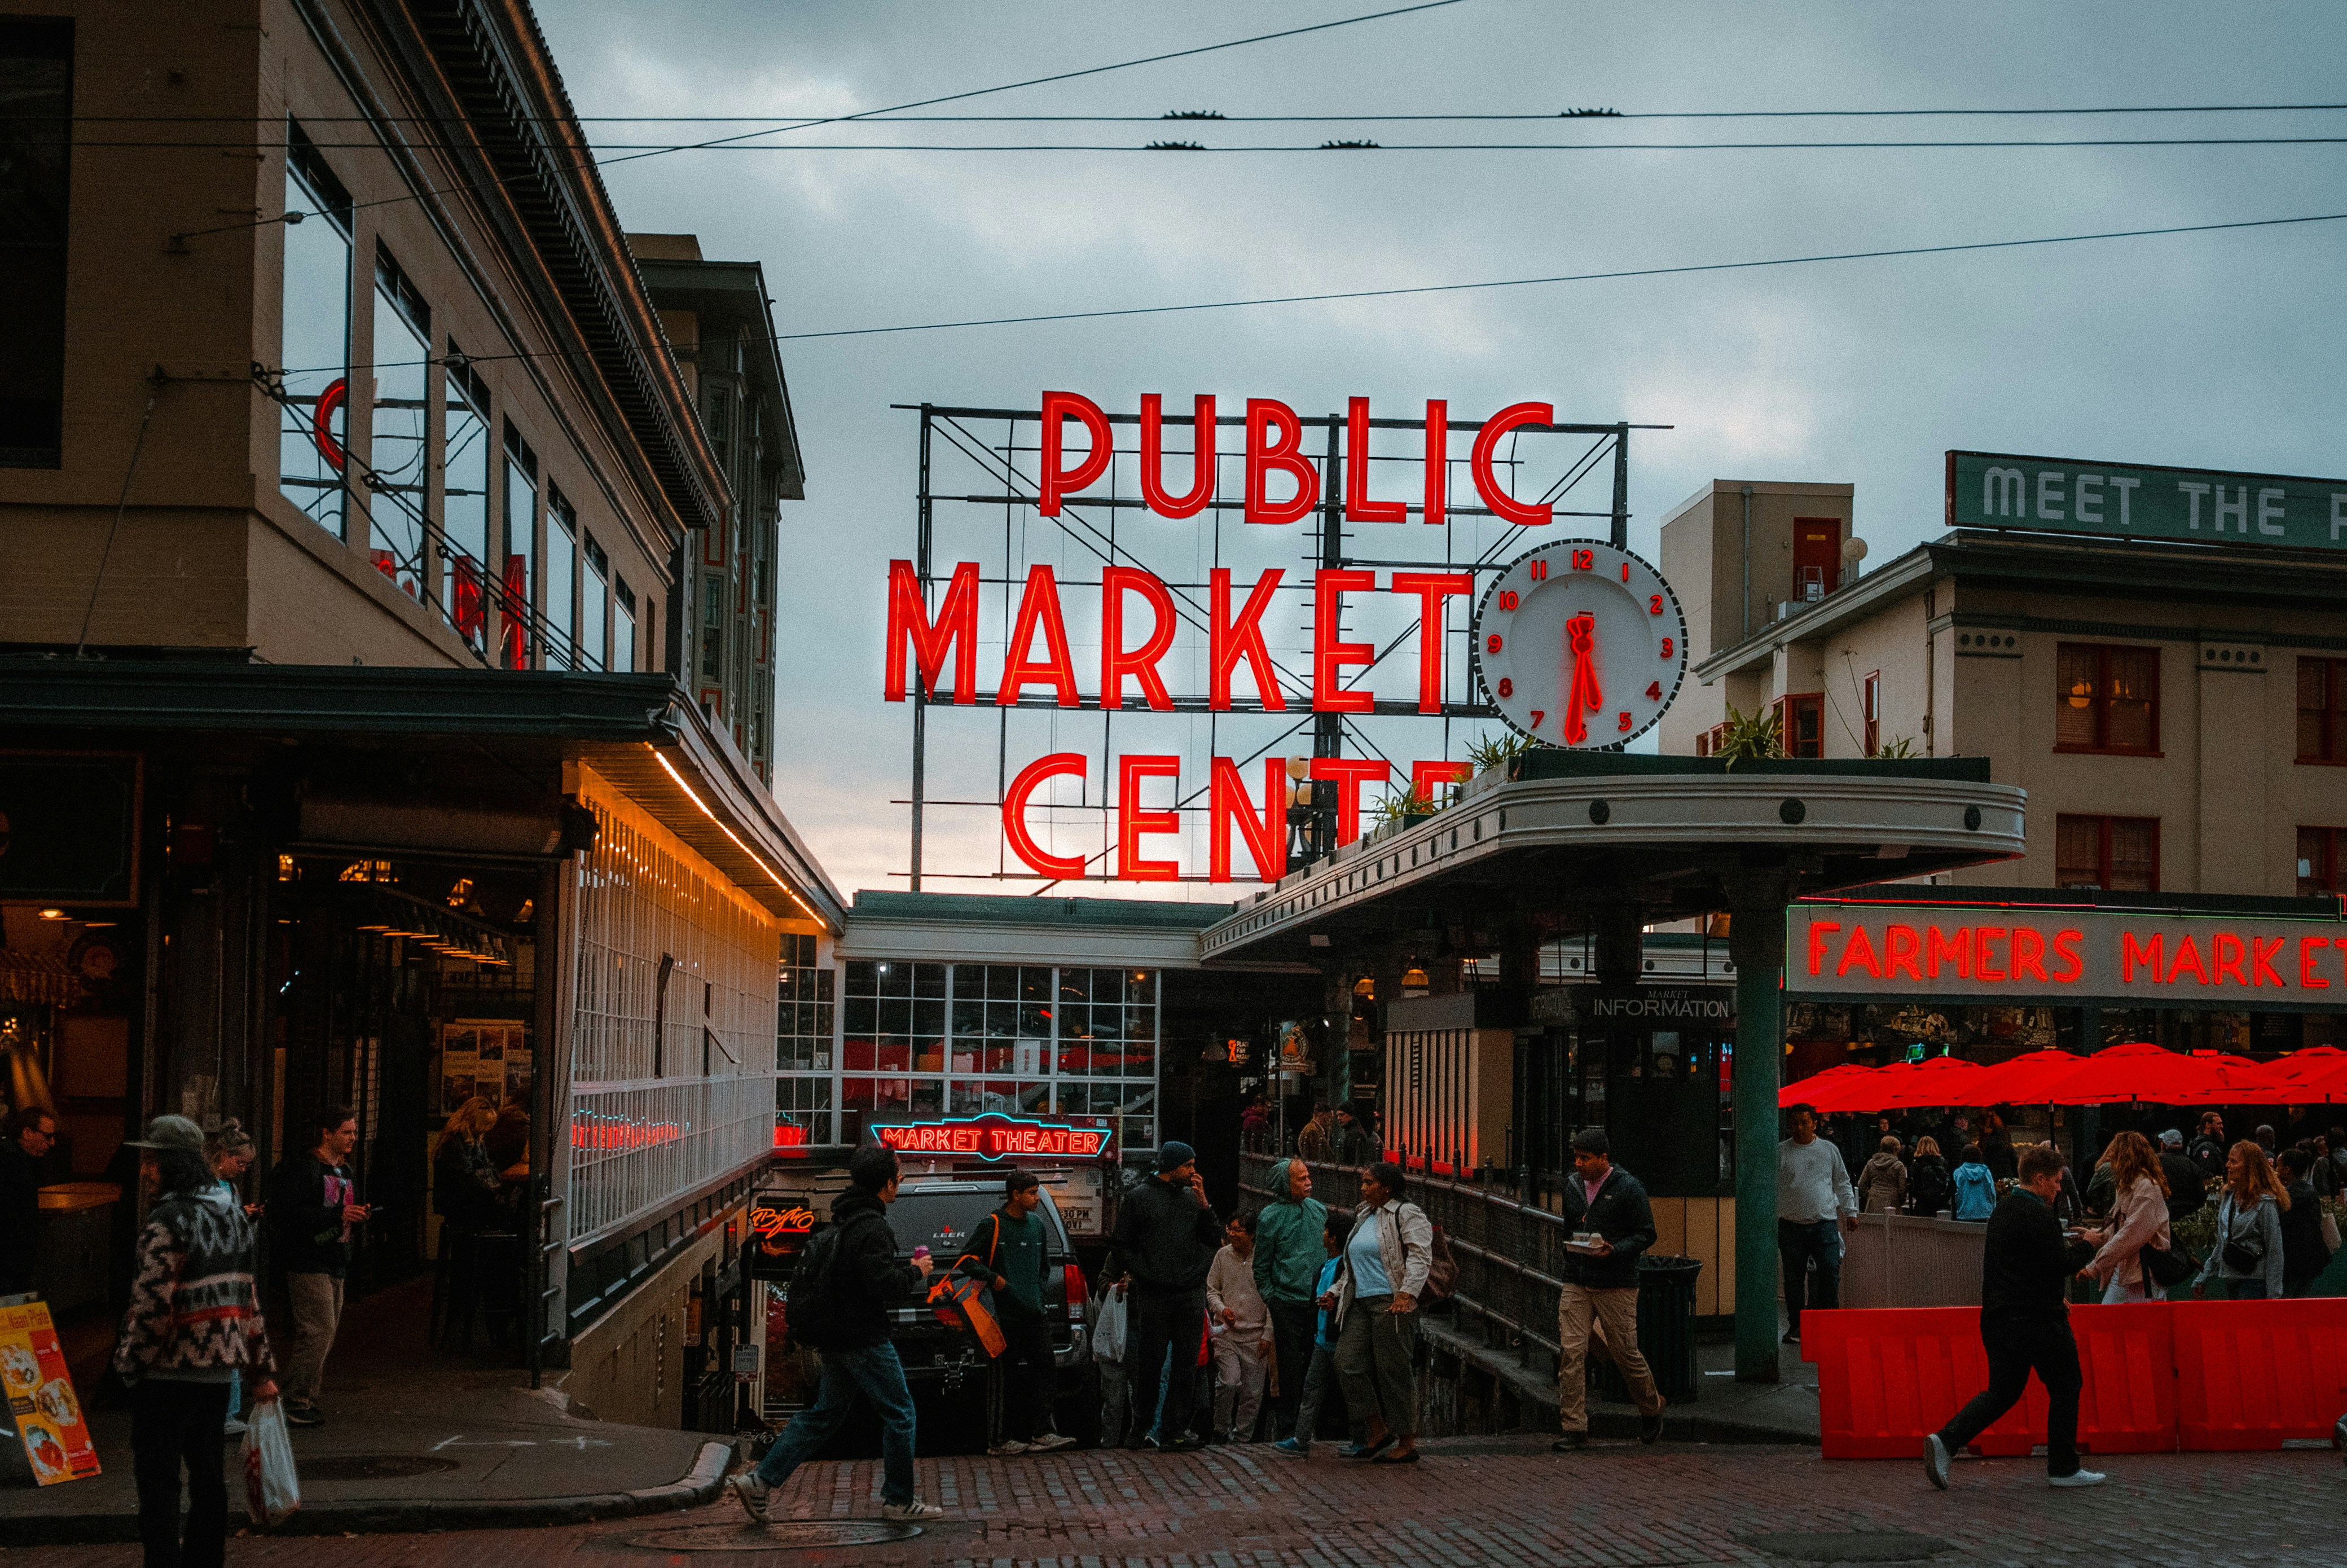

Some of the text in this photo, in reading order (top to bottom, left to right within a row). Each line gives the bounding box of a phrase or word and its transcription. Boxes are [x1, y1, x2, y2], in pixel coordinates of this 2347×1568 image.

[1040, 390, 1553, 526] PUBLIC
[1984, 467, 2141, 524] MEET
[2178, 482, 2284, 535] THE
[1572, 549, 1594, 569] 12
[1531, 560, 1547, 580] 11
[1622, 563, 1629, 582] 1
[1499, 591, 1519, 610] 10
[1650, 595, 1663, 614] 2
[885, 559, 1473, 713] MARKET
[1487, 634, 1502, 653] 9
[1660, 638, 1673, 658] 3
[1498, 678, 1513, 698] 8
[1645, 681, 1663, 701] 4
[1530, 710, 1545, 730] 7
[1618, 712, 1632, 731] 5
[1808, 921, 2084, 983] FARMERS
[1647, 990, 1689, 999] MARKET
[1594, 999, 1728, 1017] INFORMATION
[884, 1128, 1100, 1153] MARKET THEATER
[1077, 1209, 1089, 1219] PM
